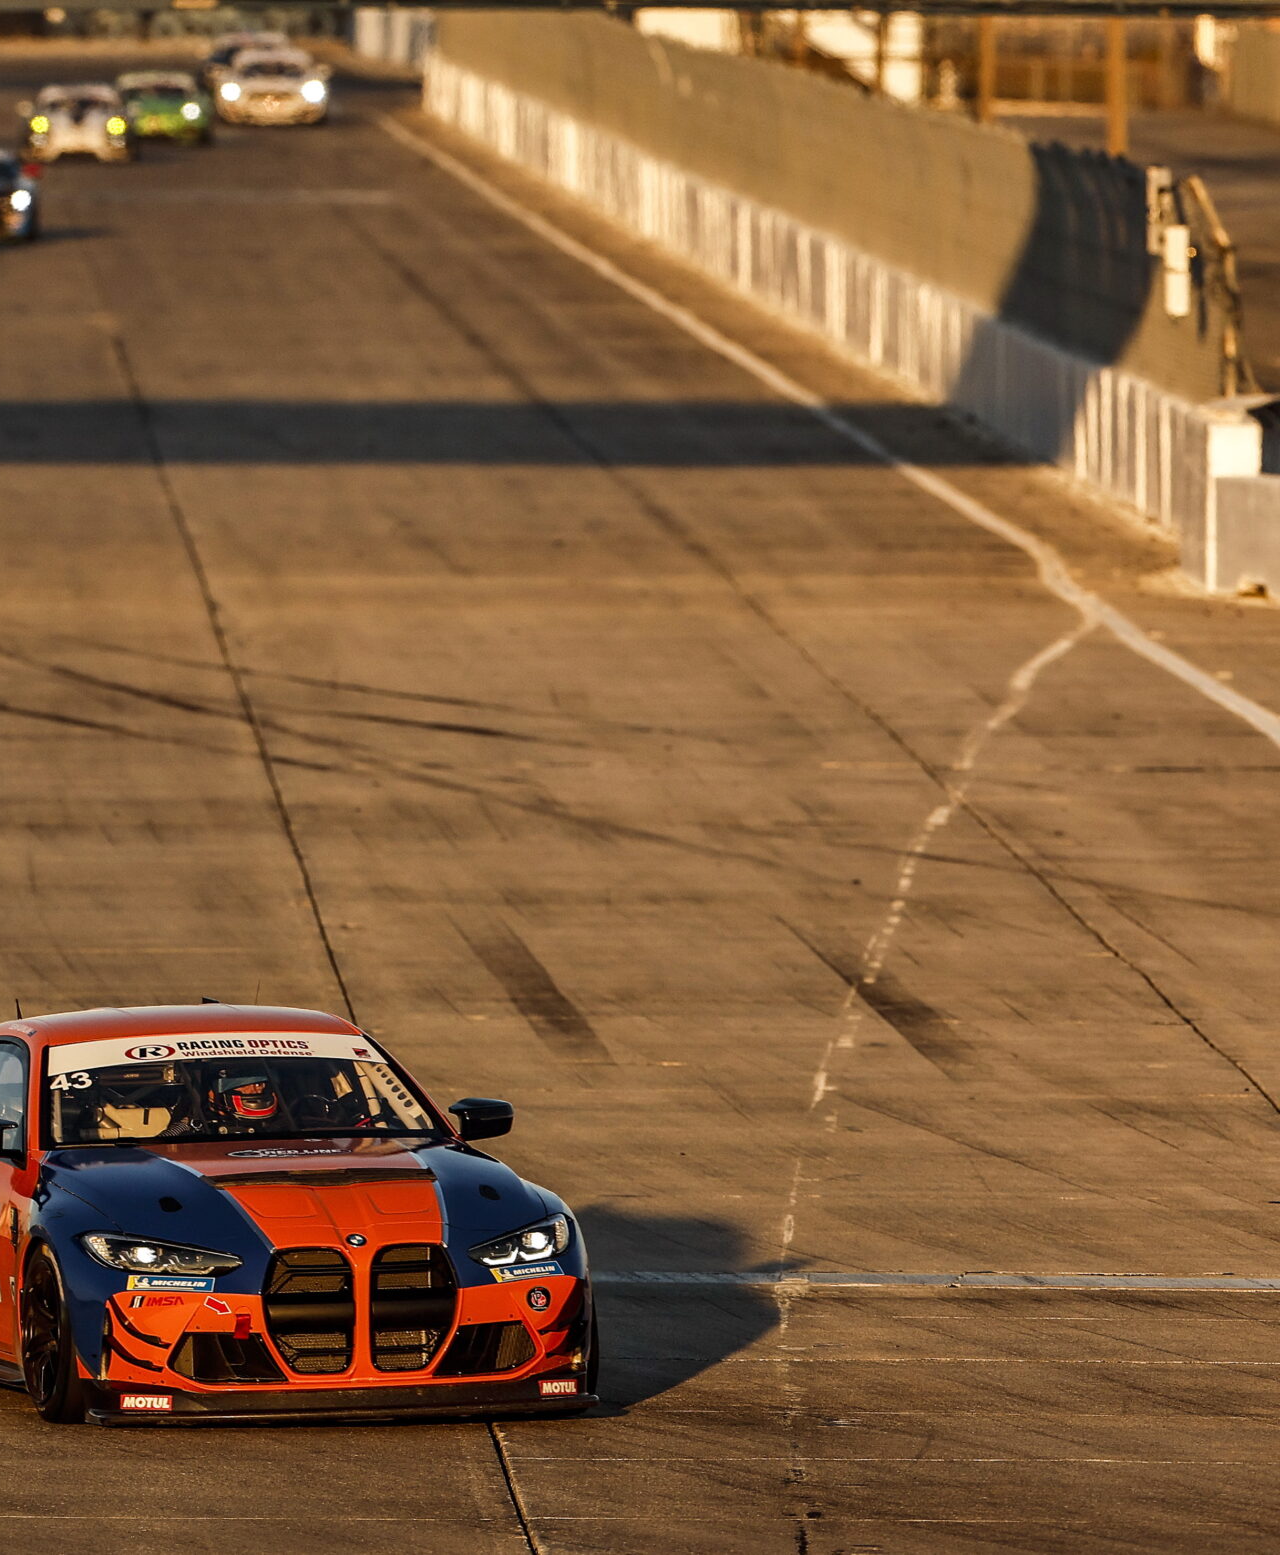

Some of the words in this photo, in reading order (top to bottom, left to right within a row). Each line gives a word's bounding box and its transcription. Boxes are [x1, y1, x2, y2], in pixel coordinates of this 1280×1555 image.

[176, 1039, 245, 1051] RACING
[246, 1039, 309, 1050] OPTICS
[181, 1049, 256, 1058] Windshield
[259, 1049, 313, 1057] Defense
[50, 1071, 93, 1091] 43
[512, 1264, 556, 1276] MICHELIN
[150, 1280, 207, 1288] MICHELIN
[145, 1296, 185, 1307] IMSA
[541, 1381, 577, 1394] MOTUL
[122, 1396, 170, 1409] MOTUL
